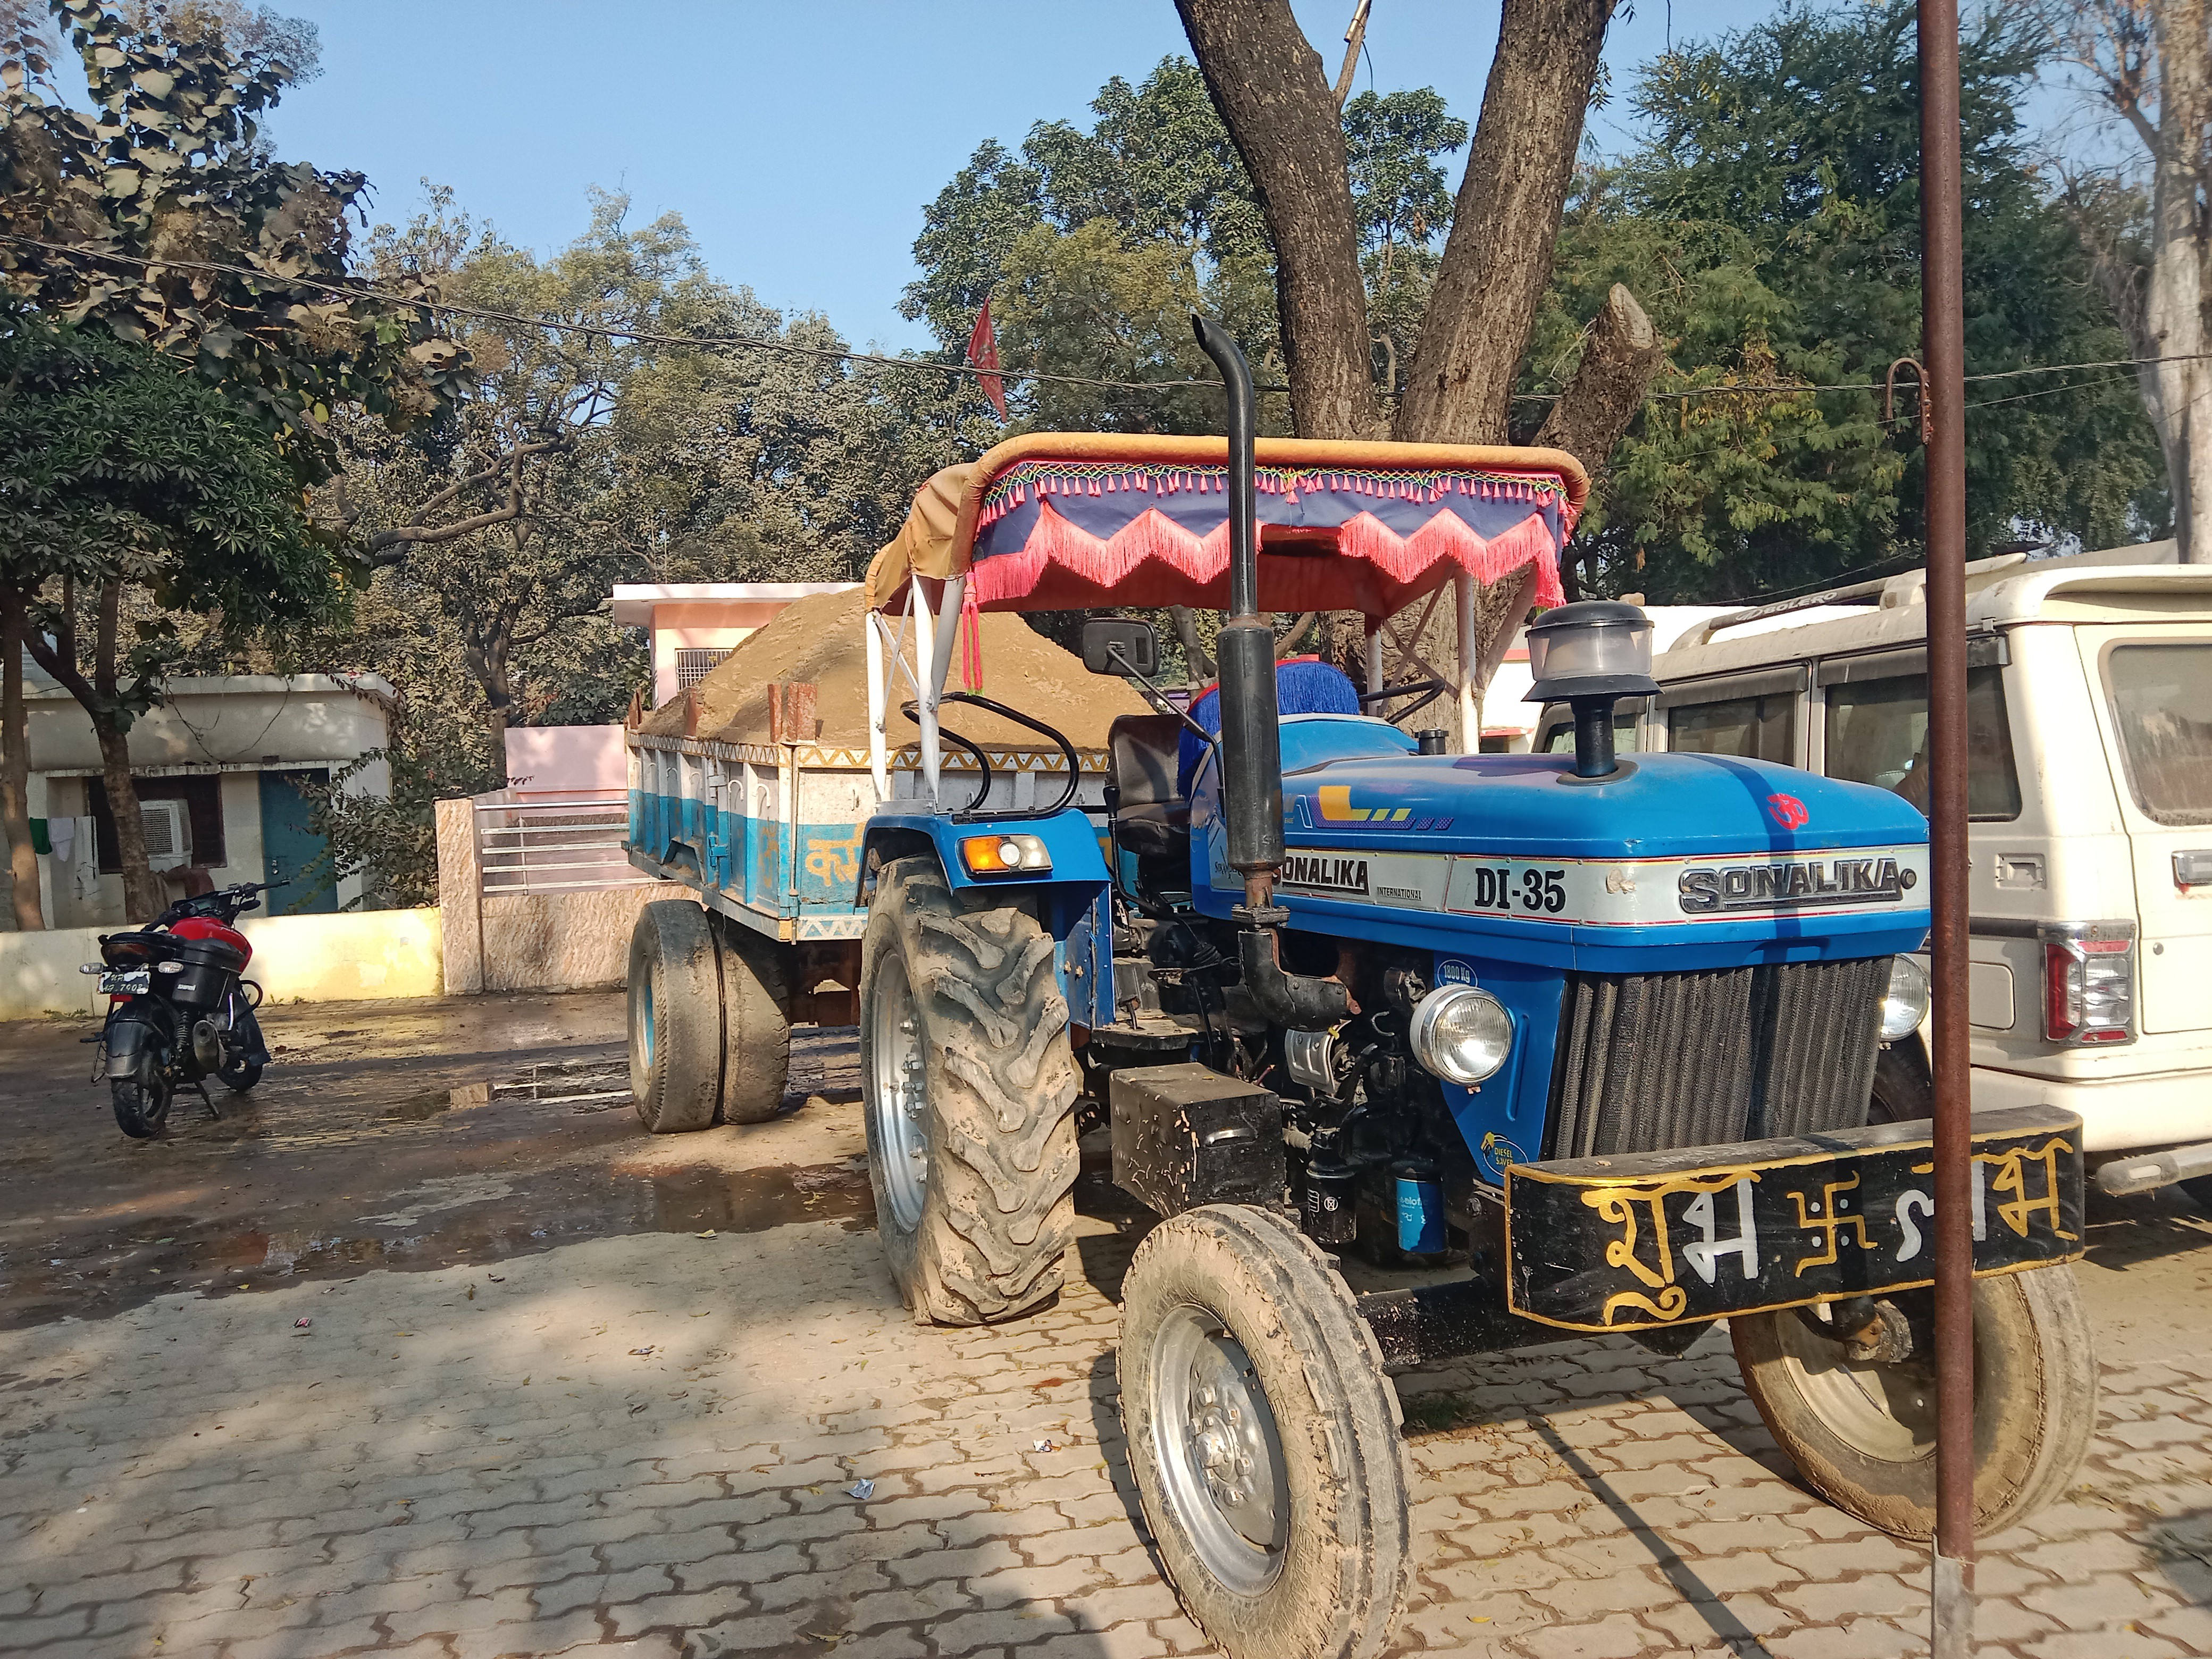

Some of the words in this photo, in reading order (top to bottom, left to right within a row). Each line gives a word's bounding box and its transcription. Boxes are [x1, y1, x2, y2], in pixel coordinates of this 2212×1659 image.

[1763, 591, 1838, 615] BOLERO
[1377, 886, 1422, 900] INTERNATIONAL
[1474, 867, 1566, 914] DI-35
[1679, 858, 1904, 914] SONALIKA
[1443, 964, 1460, 981] 1800
[1494, 1147, 1513, 1158] DIESEL
[1581, 1169, 1762, 1326] शुभ
